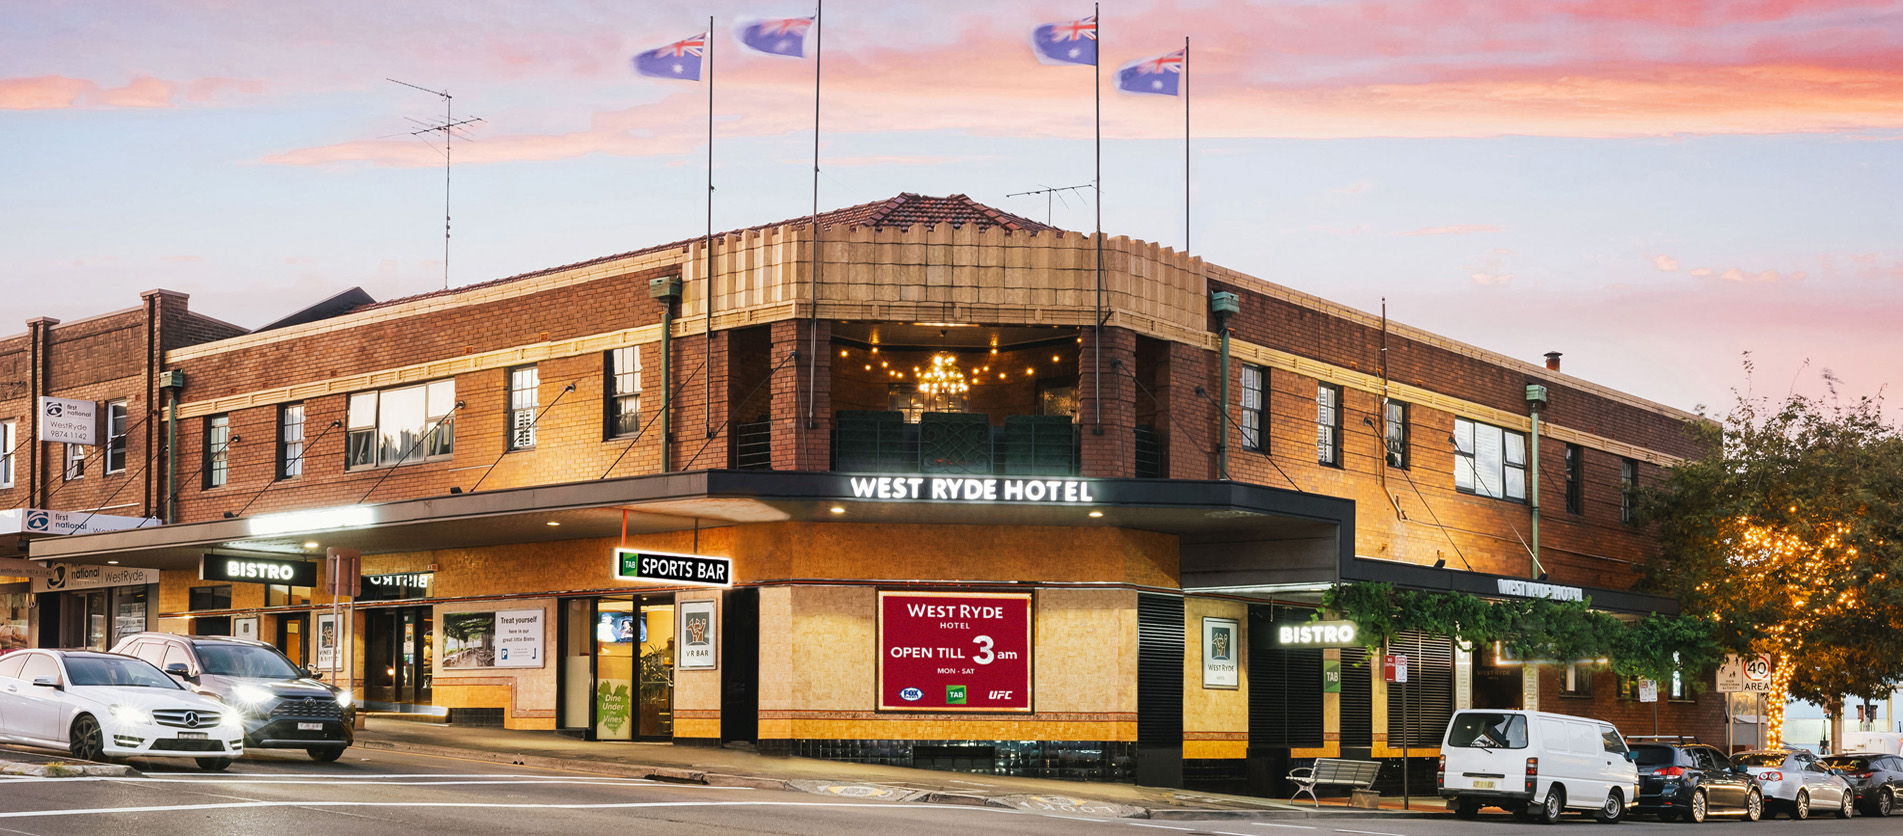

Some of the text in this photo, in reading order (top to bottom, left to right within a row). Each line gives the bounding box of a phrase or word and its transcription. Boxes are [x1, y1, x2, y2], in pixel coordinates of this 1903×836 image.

[50, 421, 88, 431] WestRyde
[50, 430, 87, 440] 9874 1142
[850, 477, 1093, 502] WEST RYDE HOTEL
[55, 513, 69, 521] first
[55, 521, 87, 530] national
[625, 560, 636, 569] TAB
[641, 557, 725, 580] SPORTS BAR
[71, 566, 100, 580] national
[226, 561, 294, 580] BISTRO
[105, 569, 144, 584] WestRyde
[1497, 579, 1525, 596] WEST
[907, 603, 1003, 619] WEST RYDE
[515, 615, 538, 625] yourself
[940, 622, 970, 630] HOTEL
[1280, 625, 1354, 643] BISTRO
[890, 635, 1018, 665] OPEN TILL 3 am
[1222, 664, 1235, 672] RYDE
[1747, 661, 1767, 675] 40
[1326, 671, 1339, 682] TAB
[1744, 682, 1770, 690] AREA
[605, 694, 622, 702] Dine
[988, 690, 1013, 700] UFC
[602, 702, 624, 711] Under
[603, 715, 622, 723] Vines
